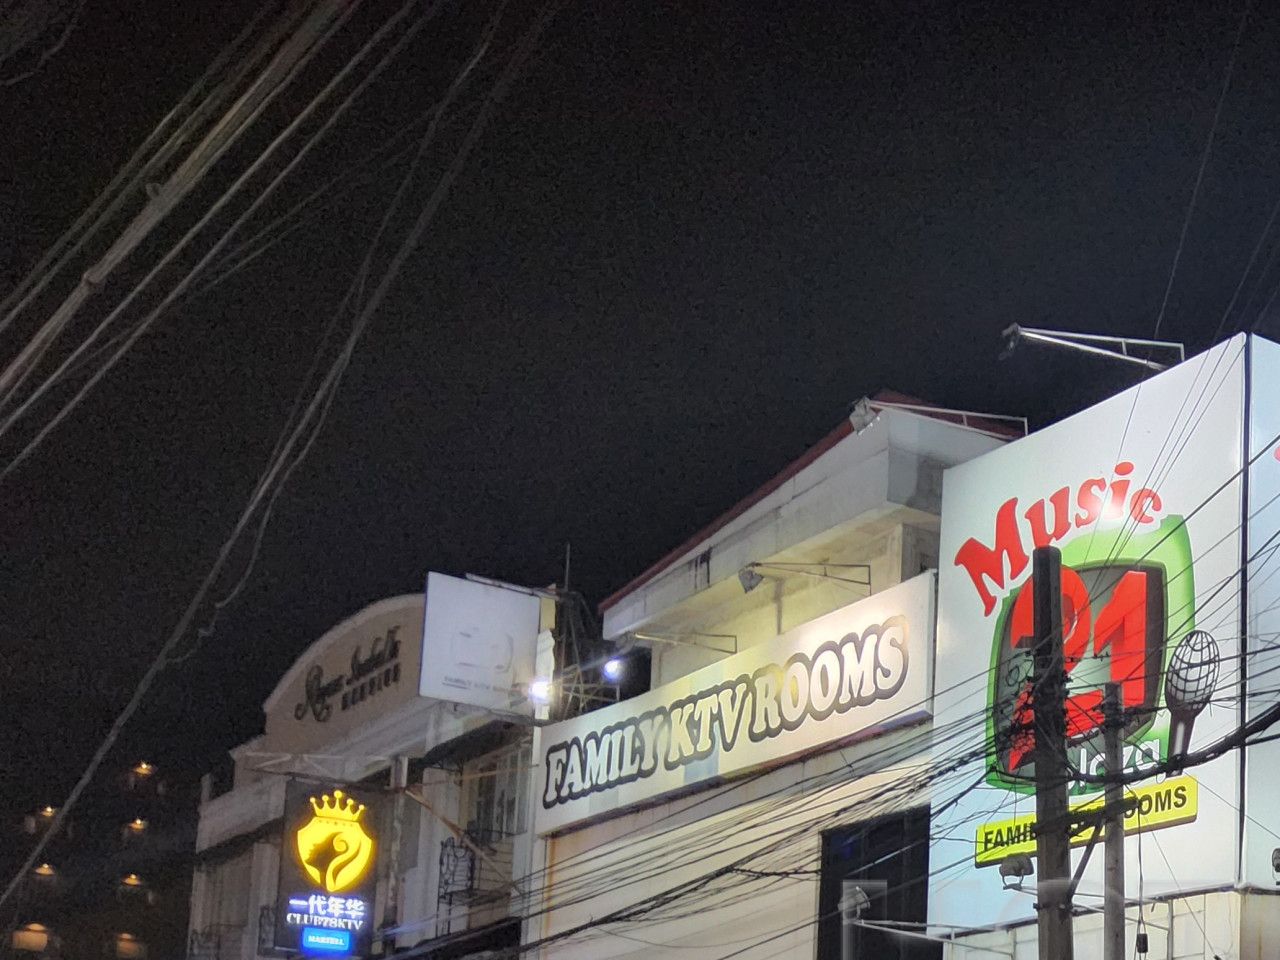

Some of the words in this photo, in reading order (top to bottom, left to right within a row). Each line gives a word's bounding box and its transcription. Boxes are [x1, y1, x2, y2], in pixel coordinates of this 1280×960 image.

[954, 461, 1163, 618] Music
[545, 706, 668, 808] FAMILY
[665, 678, 750, 766] KTV
[750, 620, 907, 738] ROOMS
[1008, 563, 1148, 772] 21
